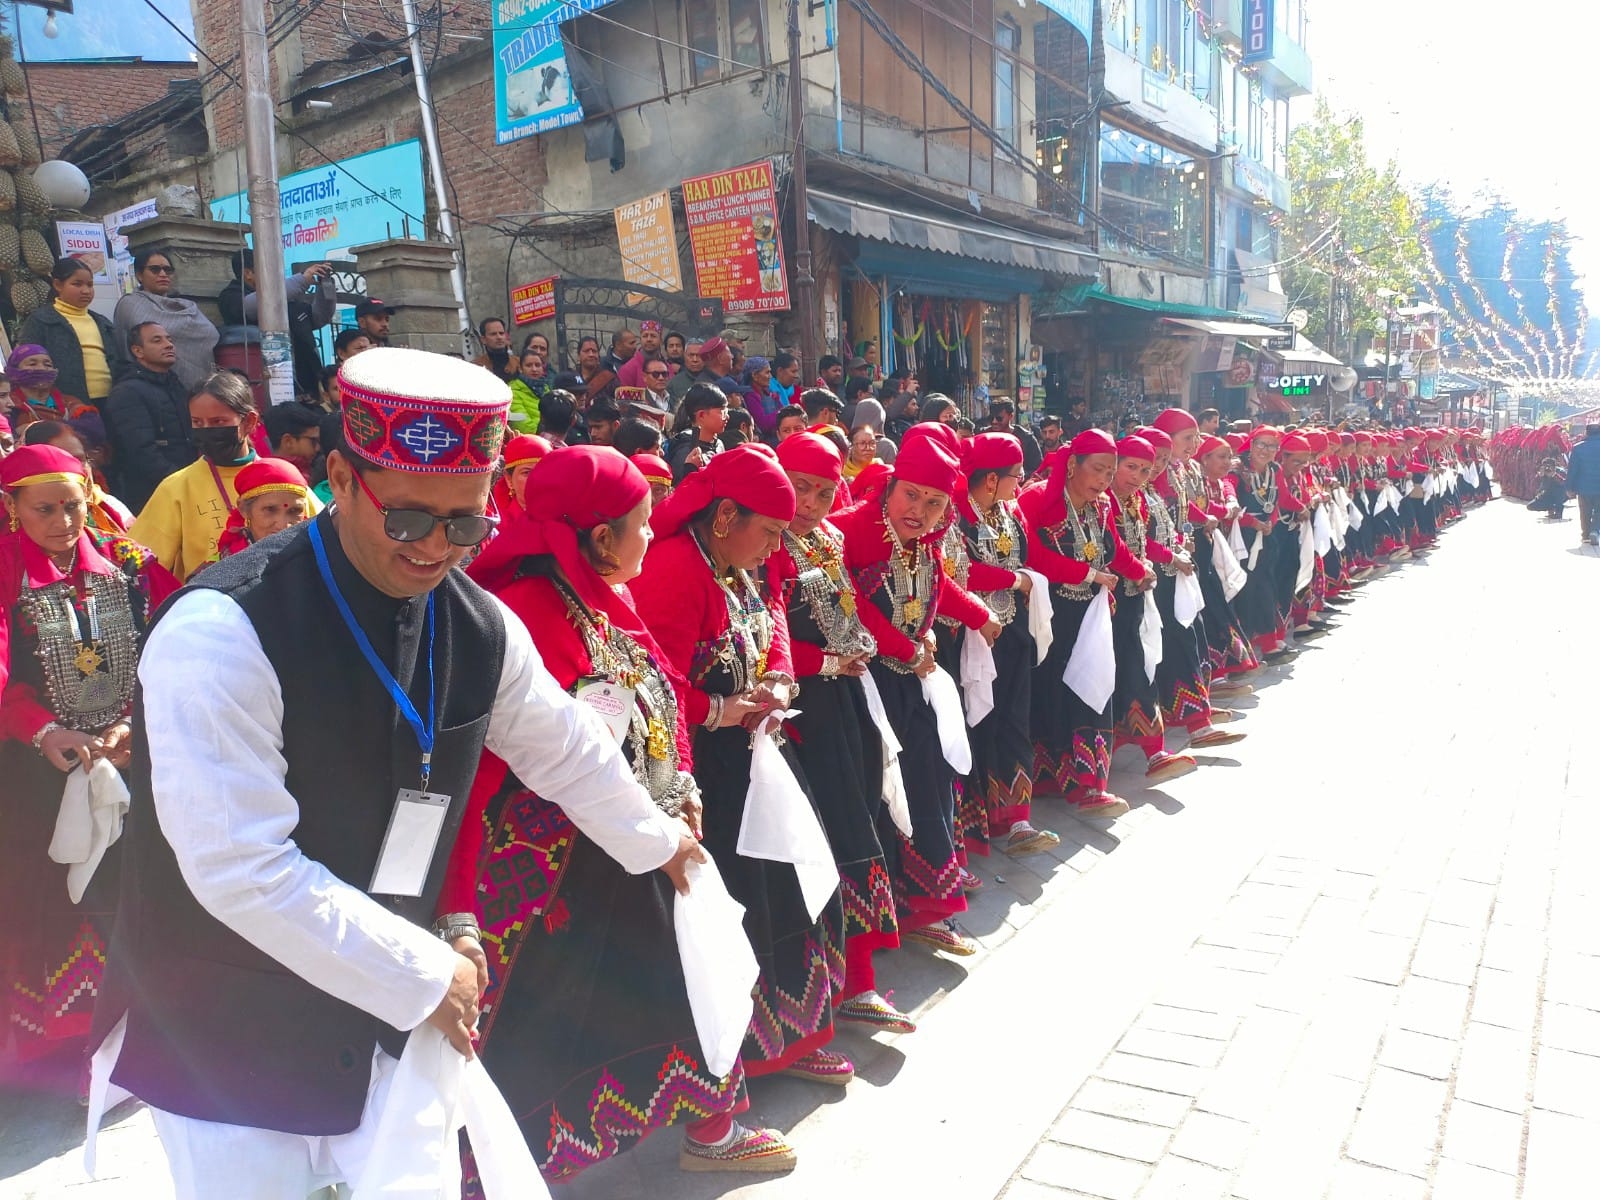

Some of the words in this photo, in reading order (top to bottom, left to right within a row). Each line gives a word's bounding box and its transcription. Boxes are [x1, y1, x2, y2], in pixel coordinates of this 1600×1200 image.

[539, 114, 560, 131] Model
[685, 181, 710, 202] HAR
[712, 174, 733, 197] DIN
[736, 167, 769, 192] TAZA
[620, 203, 641, 221] HAR
[645, 195, 664, 211] DIN
[705, 208, 724, 222] OFFICE
[725, 205, 750, 218] CANTEEN
[631, 215, 656, 231] TAZA
[67, 239, 100, 249] SIDDU
[540, 282, 553, 292] TAZ
[728, 299, 755, 311] 89089
